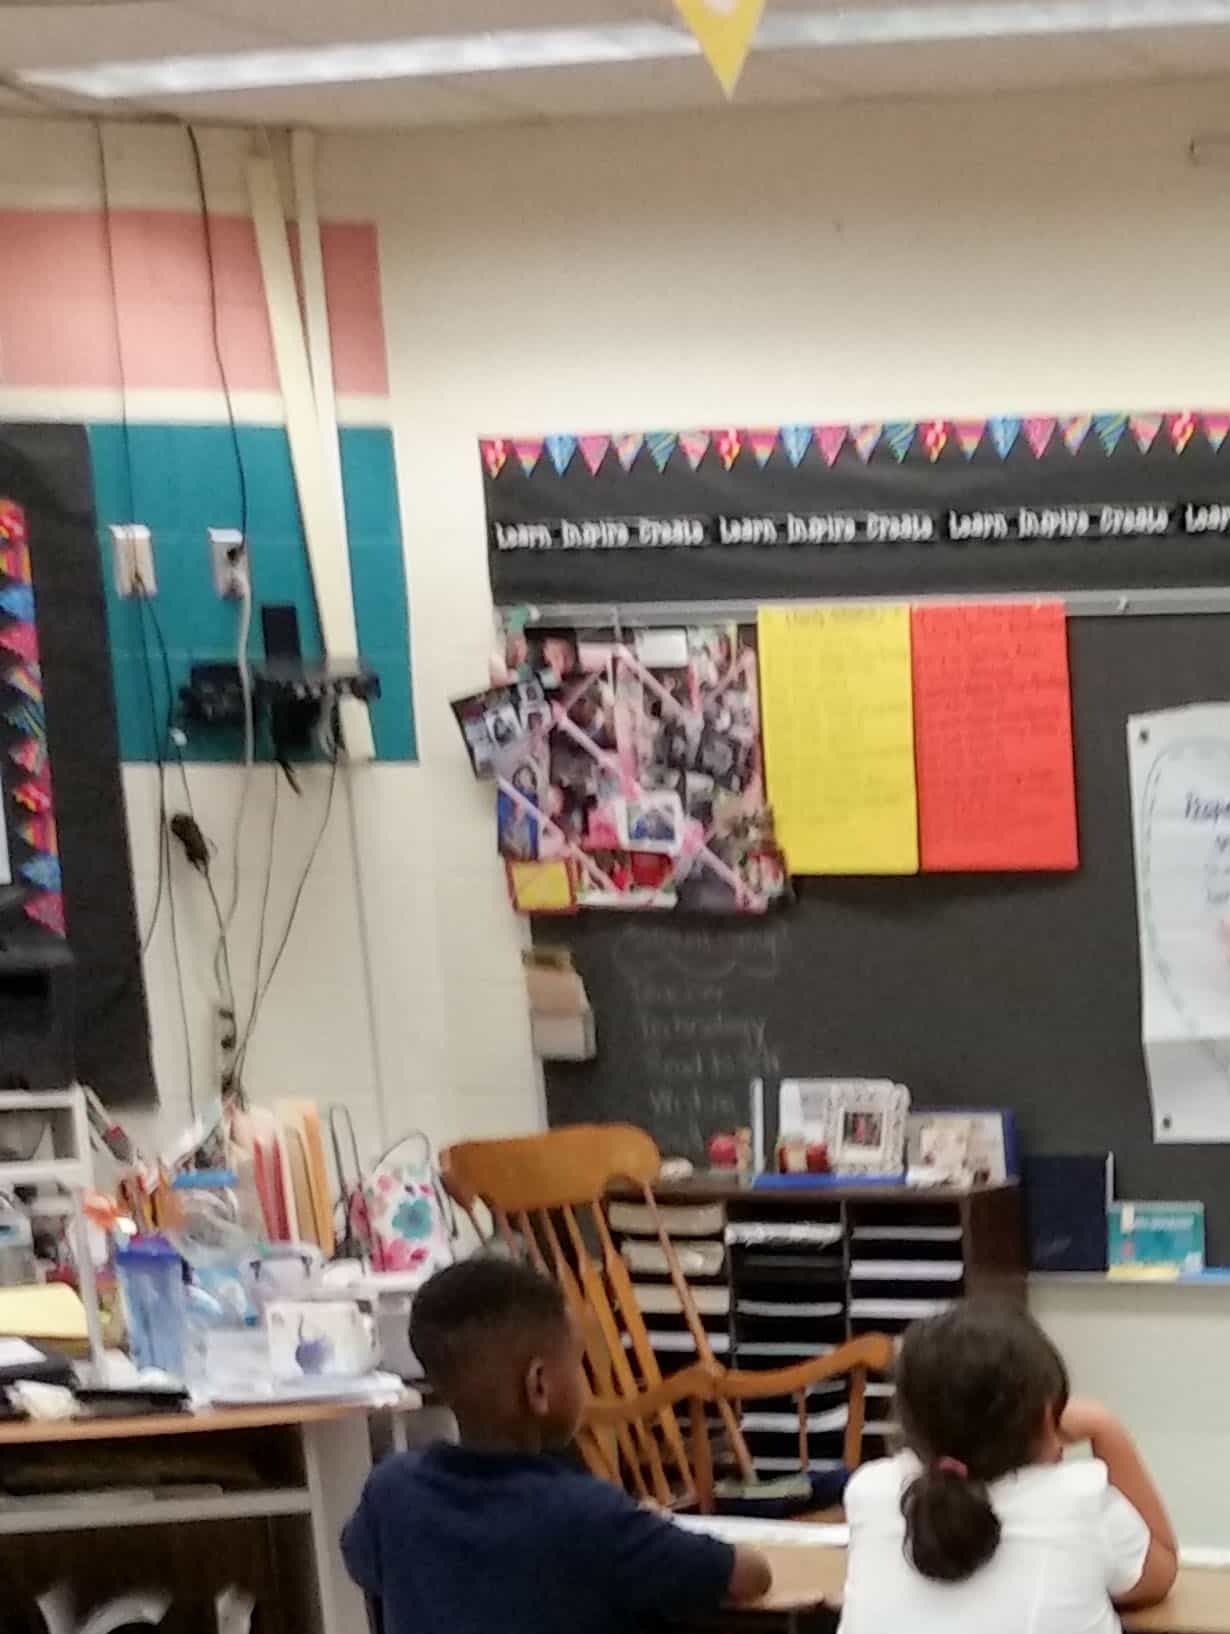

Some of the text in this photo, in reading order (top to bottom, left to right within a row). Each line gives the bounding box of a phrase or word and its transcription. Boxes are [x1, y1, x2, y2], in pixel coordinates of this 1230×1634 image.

[496, 521, 552, 549] Learn
[560, 518, 629, 548] Inspire
[638, 514, 704, 545] Create
[719, 514, 777, 544] Learn
[787, 512, 856, 544] Inspire
[866, 511, 933, 542] Create
[949, 509, 1008, 539] Learn
[1018, 506, 1089, 539] Inspire
[1101, 505, 1169, 535] Create
